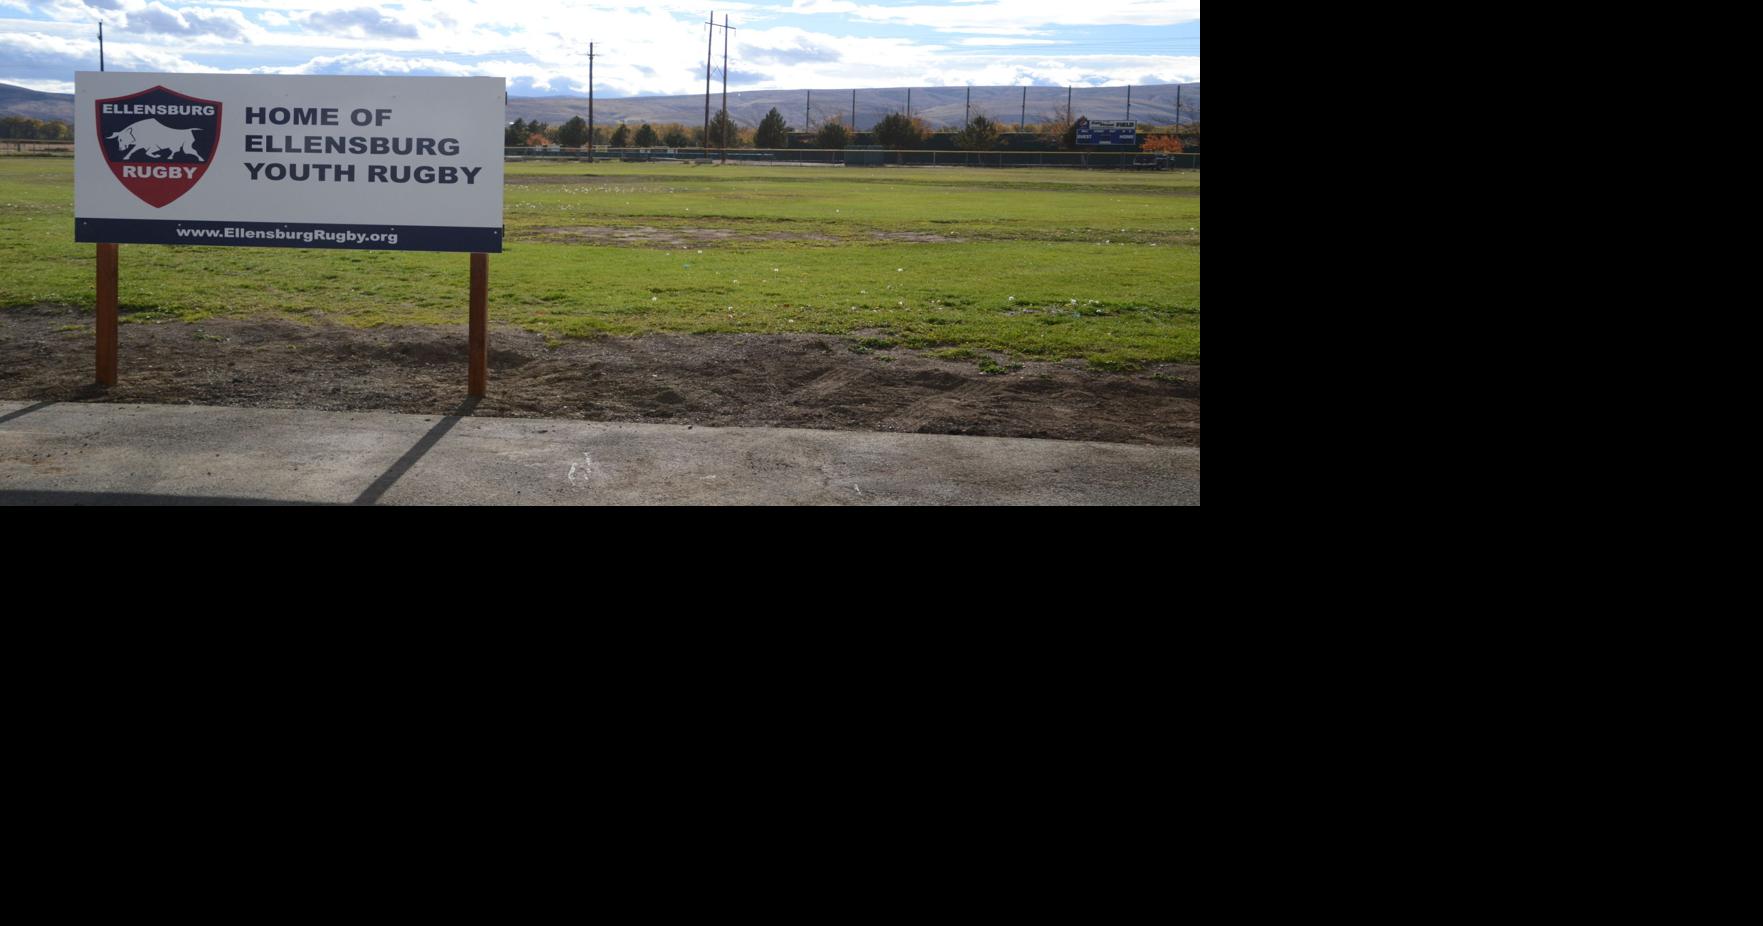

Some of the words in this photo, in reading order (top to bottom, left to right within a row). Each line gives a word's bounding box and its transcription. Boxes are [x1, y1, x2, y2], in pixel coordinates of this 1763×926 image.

[102, 103, 216, 116] ELLENSBURG
[245, 106, 339, 126] HOME
[350, 108, 393, 127] OF
[244, 134, 460, 156] ELLENSBURG
[122, 165, 198, 180] RUGBY
[243, 162, 355, 182] YOUTH
[367, 164, 483, 185] RUGBY
[176, 227, 399, 245] www.EllensburgRugby.org
